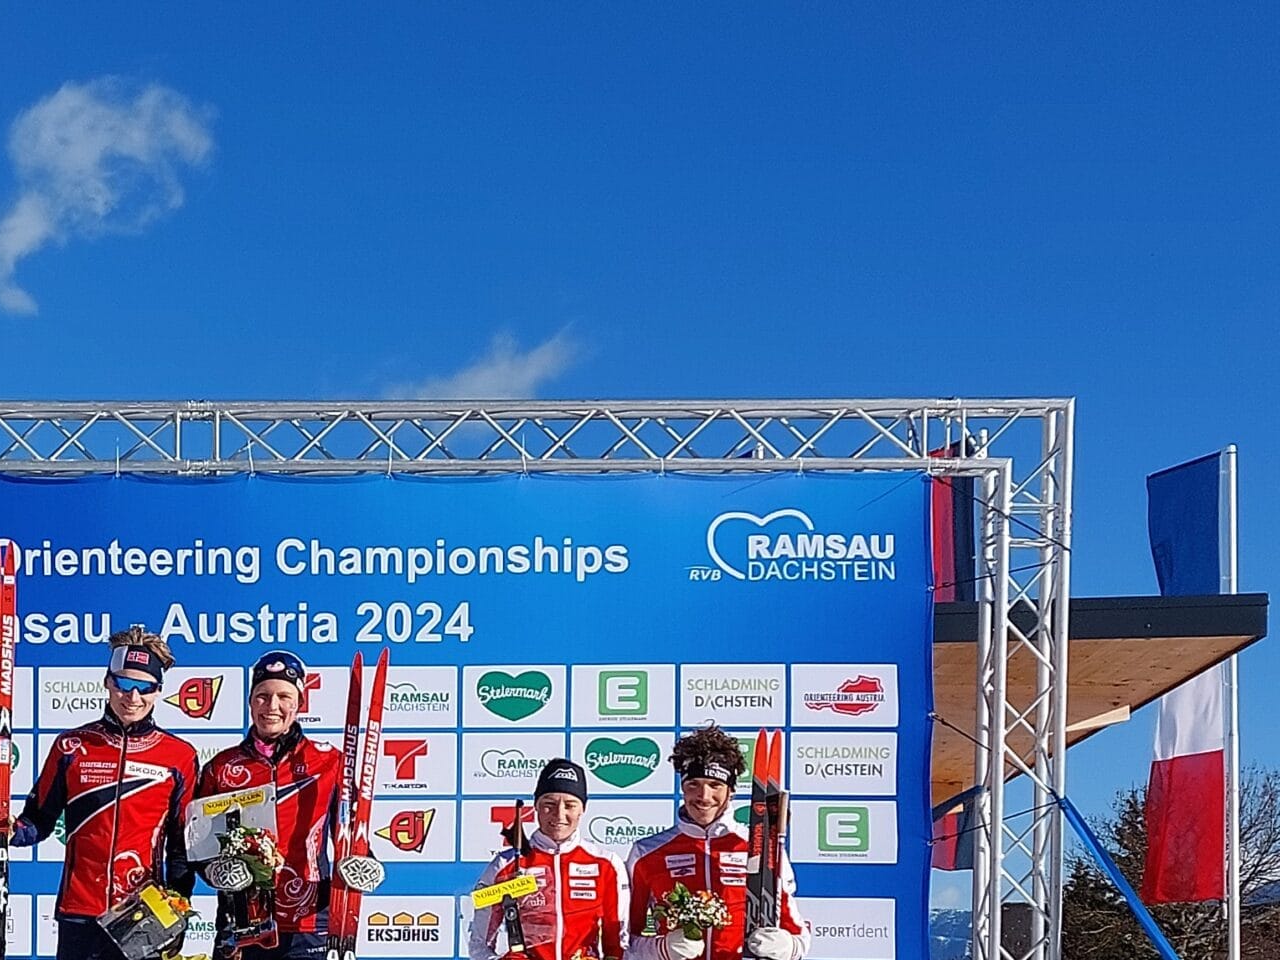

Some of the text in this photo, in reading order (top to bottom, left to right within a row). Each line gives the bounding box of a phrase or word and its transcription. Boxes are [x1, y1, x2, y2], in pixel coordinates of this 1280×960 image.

[748, 534, 894, 559] RAMSAU
[276, 536, 629, 582] Championships
[689, 561, 896, 581] RVB DACHSTEIN
[161, 602, 338, 644] Austria
[356, 602, 474, 643] 2024
[0, 615, 13, 696] MADSHUS
[44, 681, 106, 693] SCHLADM
[687, 678, 779, 691] SCHLADMING
[390, 693, 449, 702] RAMSAU
[479, 685, 548, 703] Steiermark
[804, 693, 885, 702] ORIENTEERING AUSTRIA
[52, 697, 108, 713] DACHST
[390, 703, 449, 712] DACHSTEIN
[695, 695, 772, 710] DACHSTEIN
[361, 719, 380, 800] MADSHUS
[797, 746, 890, 759] SCHLADMING
[342, 725, 358, 799] MADSHUS
[498, 759, 550, 769] RAMSA
[587, 752, 657, 770] Steiermark
[497, 769, 539, 777] DACHST
[805, 763, 882, 778] DACHSTEIN
[605, 837, 638, 845] DACHS
